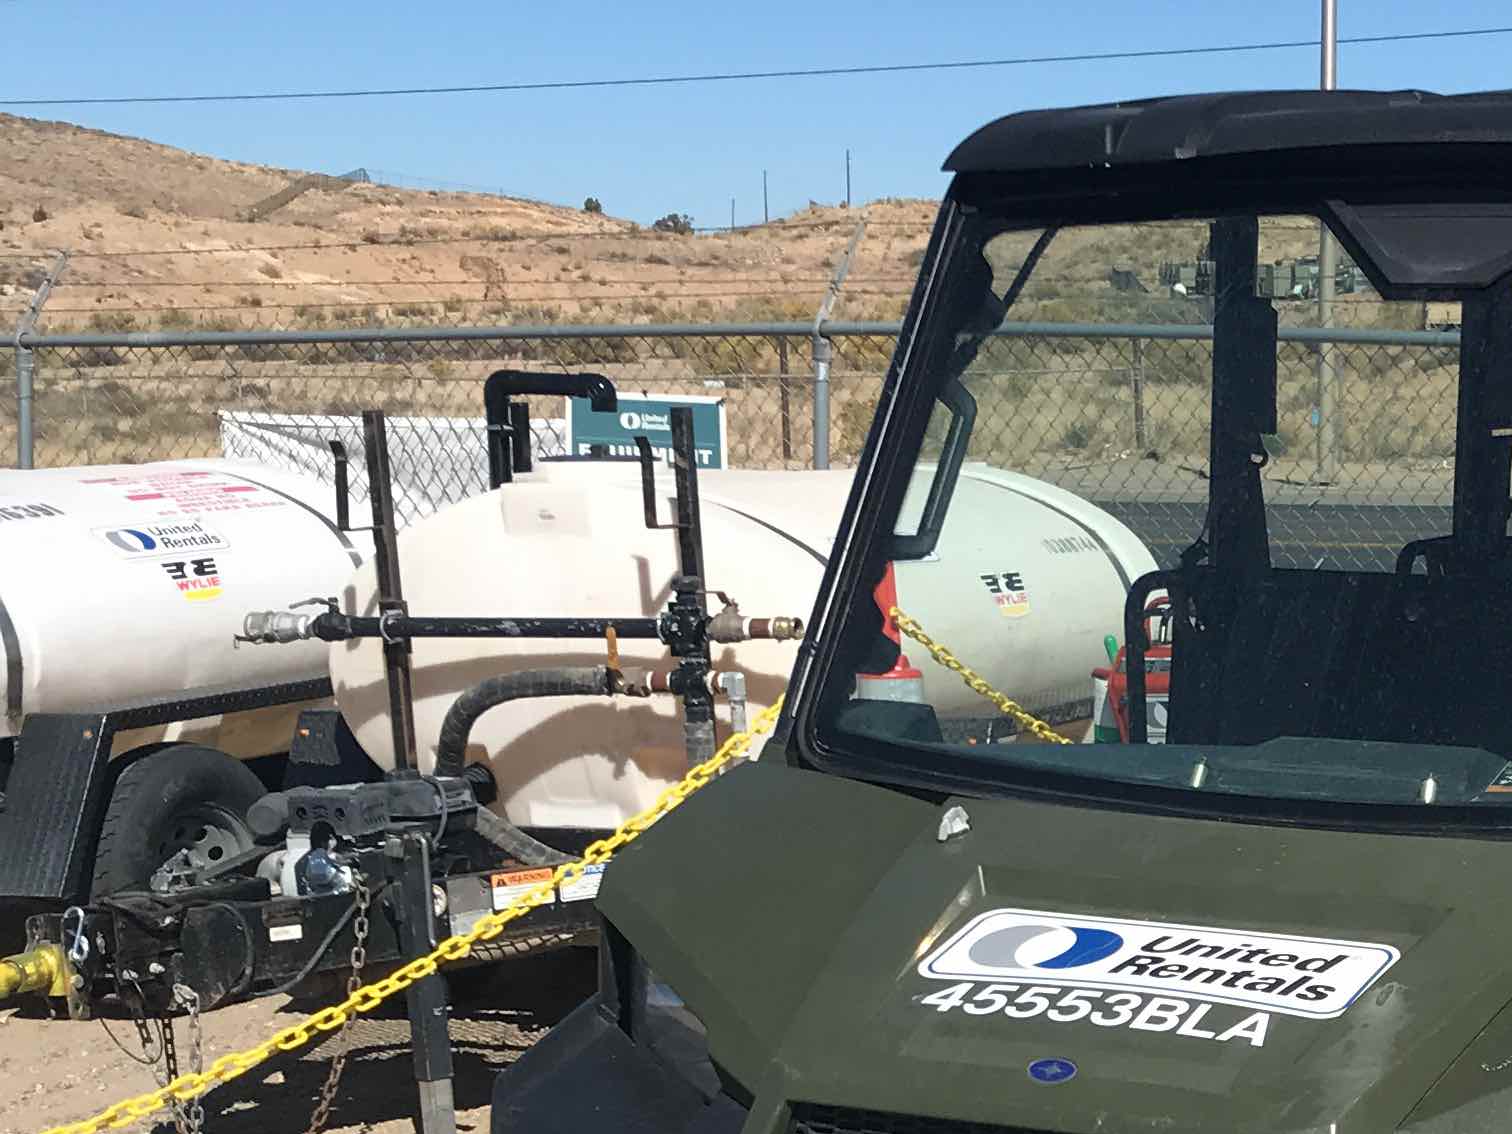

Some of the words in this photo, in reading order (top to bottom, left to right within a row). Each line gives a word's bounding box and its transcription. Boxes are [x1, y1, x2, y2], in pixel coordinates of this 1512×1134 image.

[147, 522, 203, 536] United
[160, 533, 221, 549] Rentals
[175, 576, 222, 591] WYLIE
[1140, 935, 1349, 974] United
[1107, 954, 1337, 1002] Rentals
[920, 982, 1271, 1047] 45553BLA
